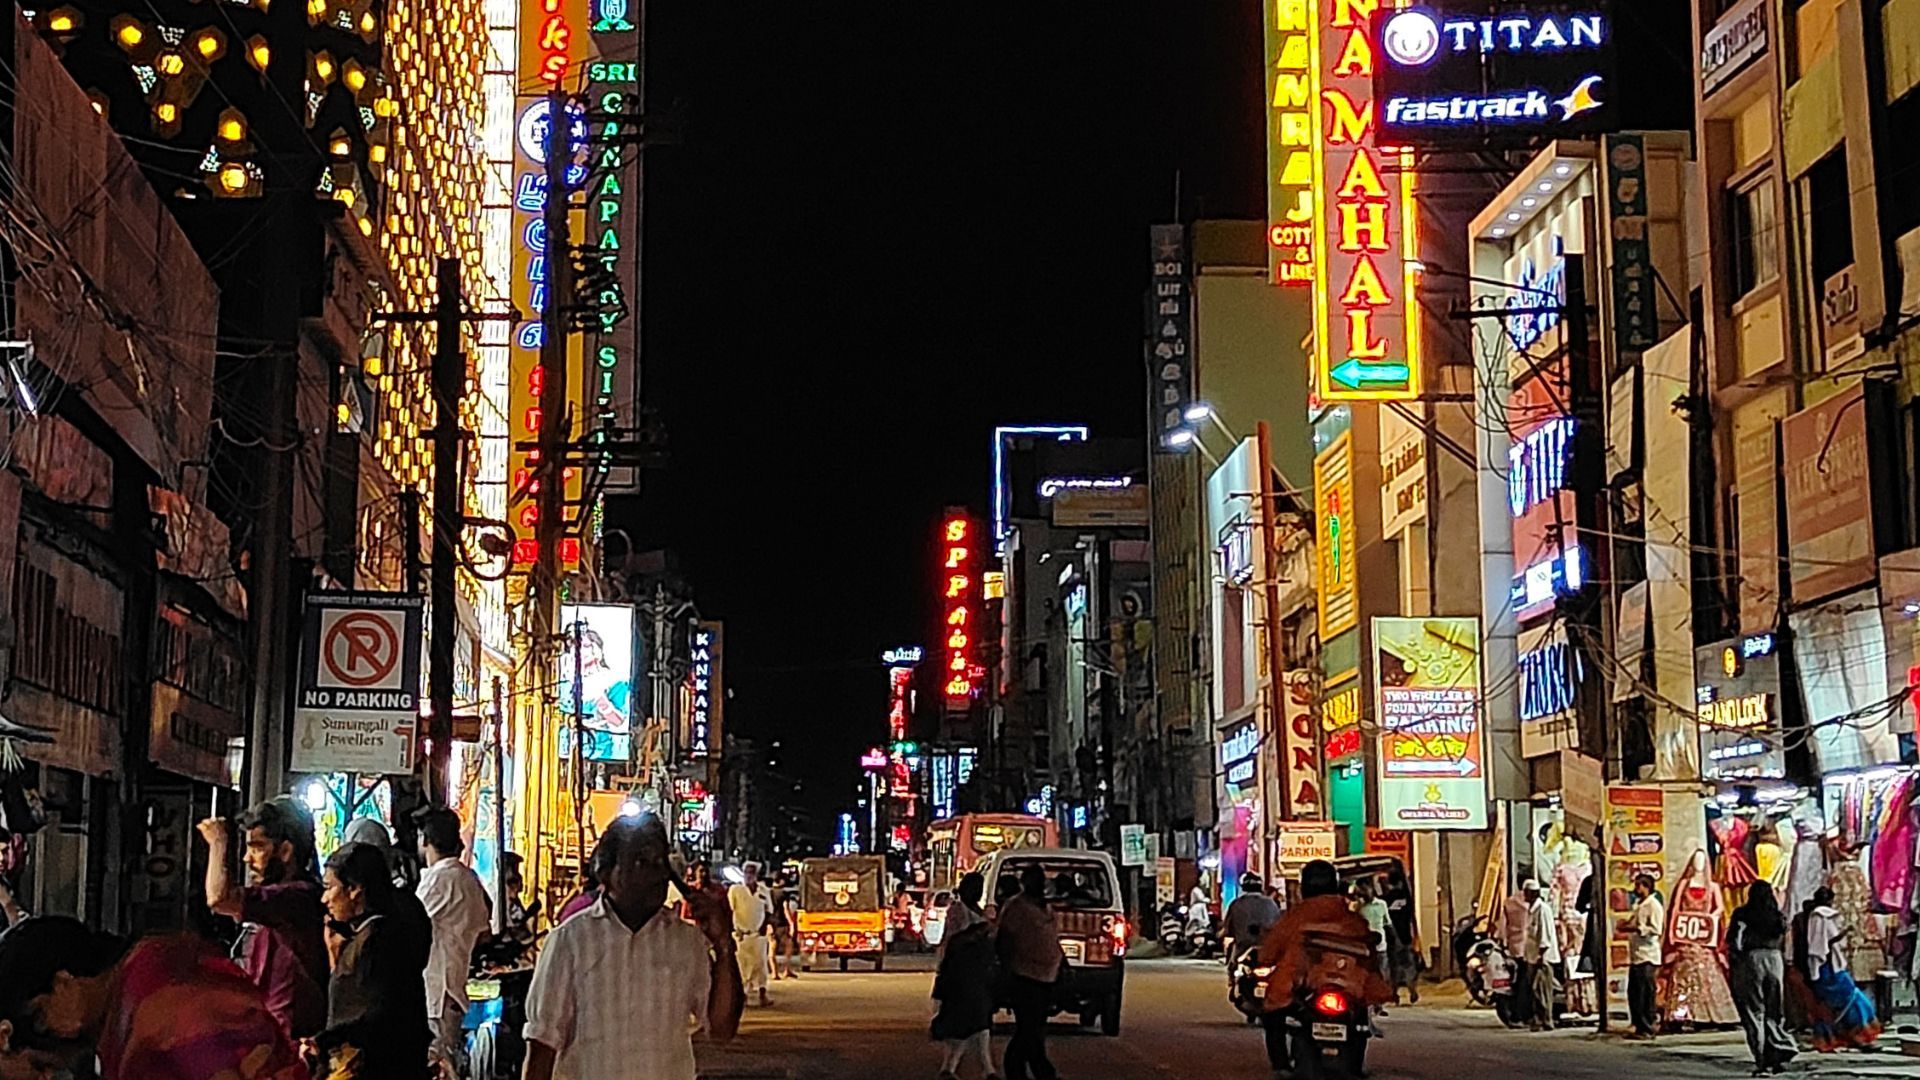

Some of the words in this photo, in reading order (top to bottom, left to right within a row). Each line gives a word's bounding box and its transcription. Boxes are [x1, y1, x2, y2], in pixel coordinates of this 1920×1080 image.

[1443, 17, 1601, 50] TITAN
[591, 63, 637, 82] SRI
[1386, 91, 1548, 123] fastrack
[1295, 246, 1310, 262] &
[1518, 640, 1584, 720] ZIMSO
[304, 690, 330, 706] NO
[335, 692, 412, 709] PARKING
[694, 633, 709, 751] KANKARIA
[1384, 690, 1410, 702] TWO
[1384, 702, 1416, 715] FOUR
[1384, 715, 1475, 734] PARKING
[324, 732, 385, 747] Jewellers
[1297, 835, 1314, 845] NO
[1280, 847, 1332, 857] PARKING
